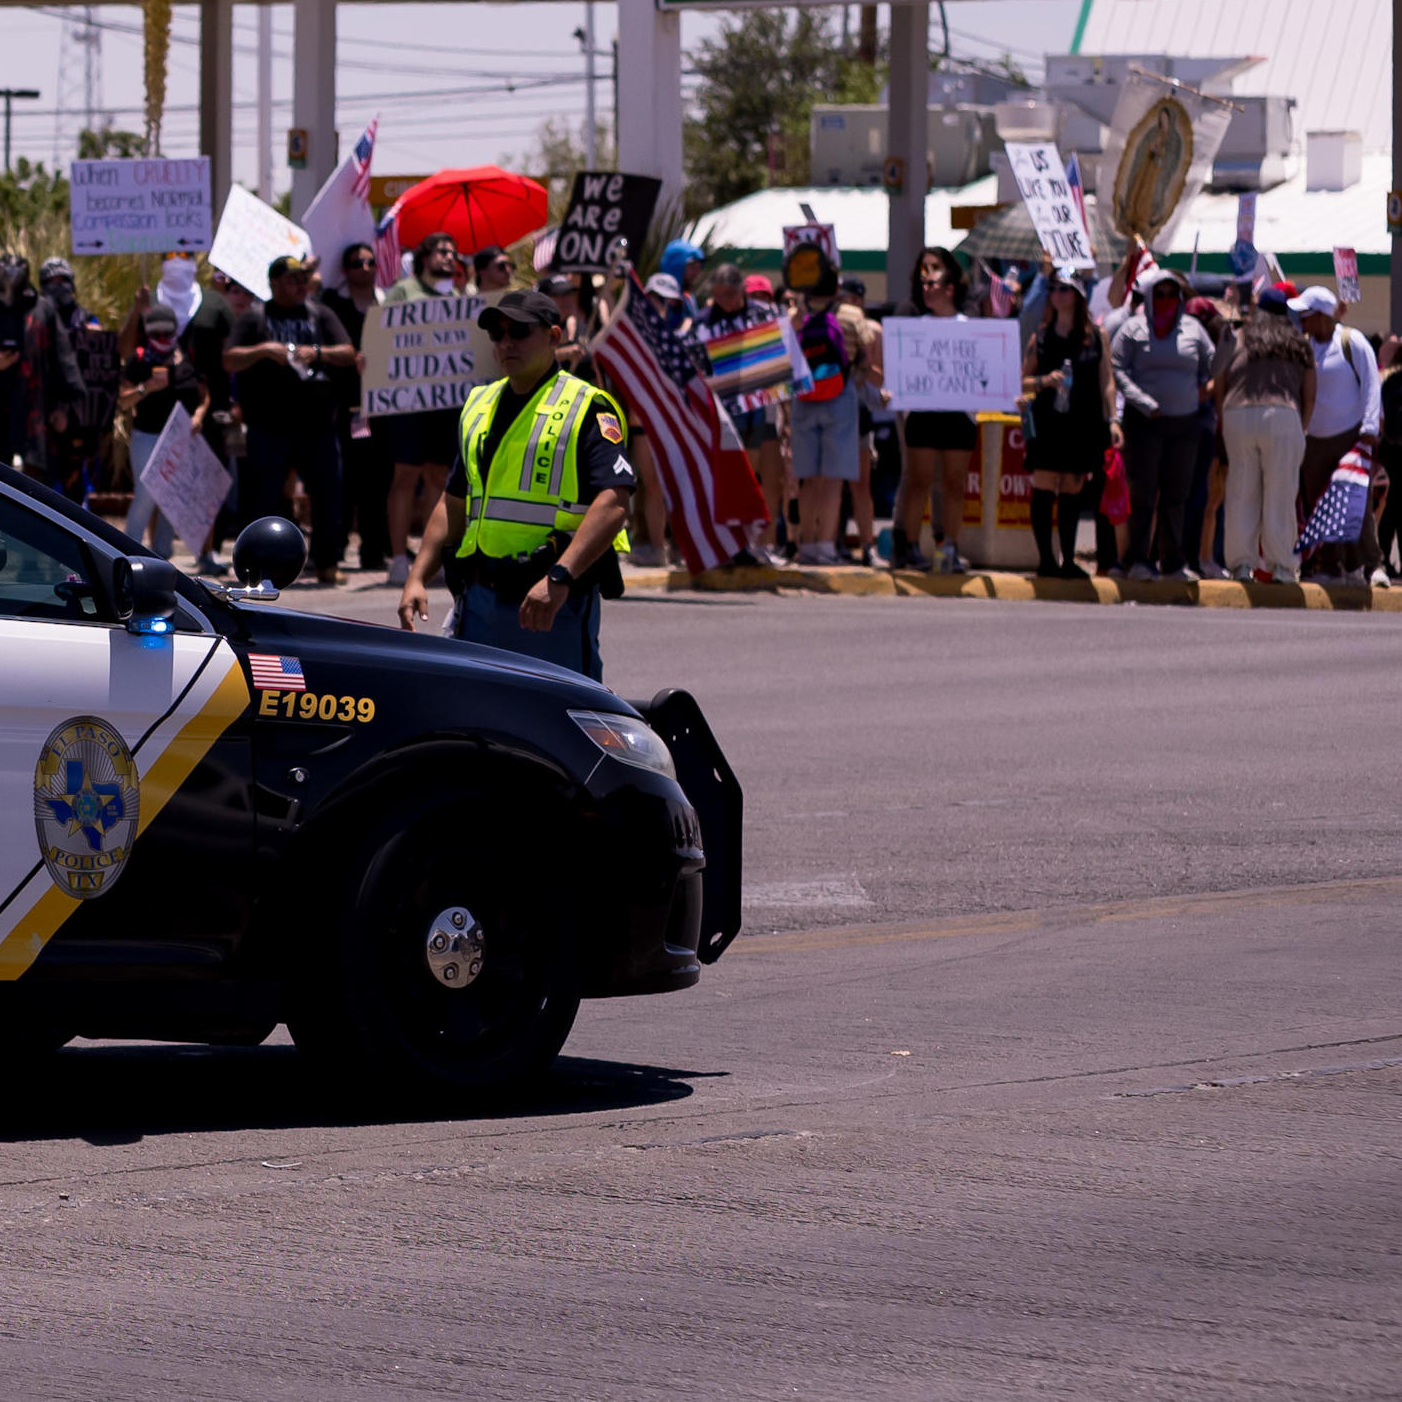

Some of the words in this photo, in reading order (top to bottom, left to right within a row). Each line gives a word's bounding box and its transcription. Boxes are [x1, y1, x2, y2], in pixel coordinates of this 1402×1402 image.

[132, 162, 207, 186] CRUELTY
[86, 193, 144, 212] becomes
[395, 332, 424, 348] THE
[432, 330, 468, 345] NEW
[930, 339, 950, 357] AM
[951, 339, 978, 358] HERE
[388, 350, 475, 380] JUDAS
[905, 374, 933, 393] WHO
[535, 399, 571, 485] POLICE
[258, 690, 376, 723] E19039
[51, 736, 72, 758] EL
[75, 724, 122, 758] PASO
[54, 850, 121, 870] POLICE
[73, 874, 97, 888] TX
